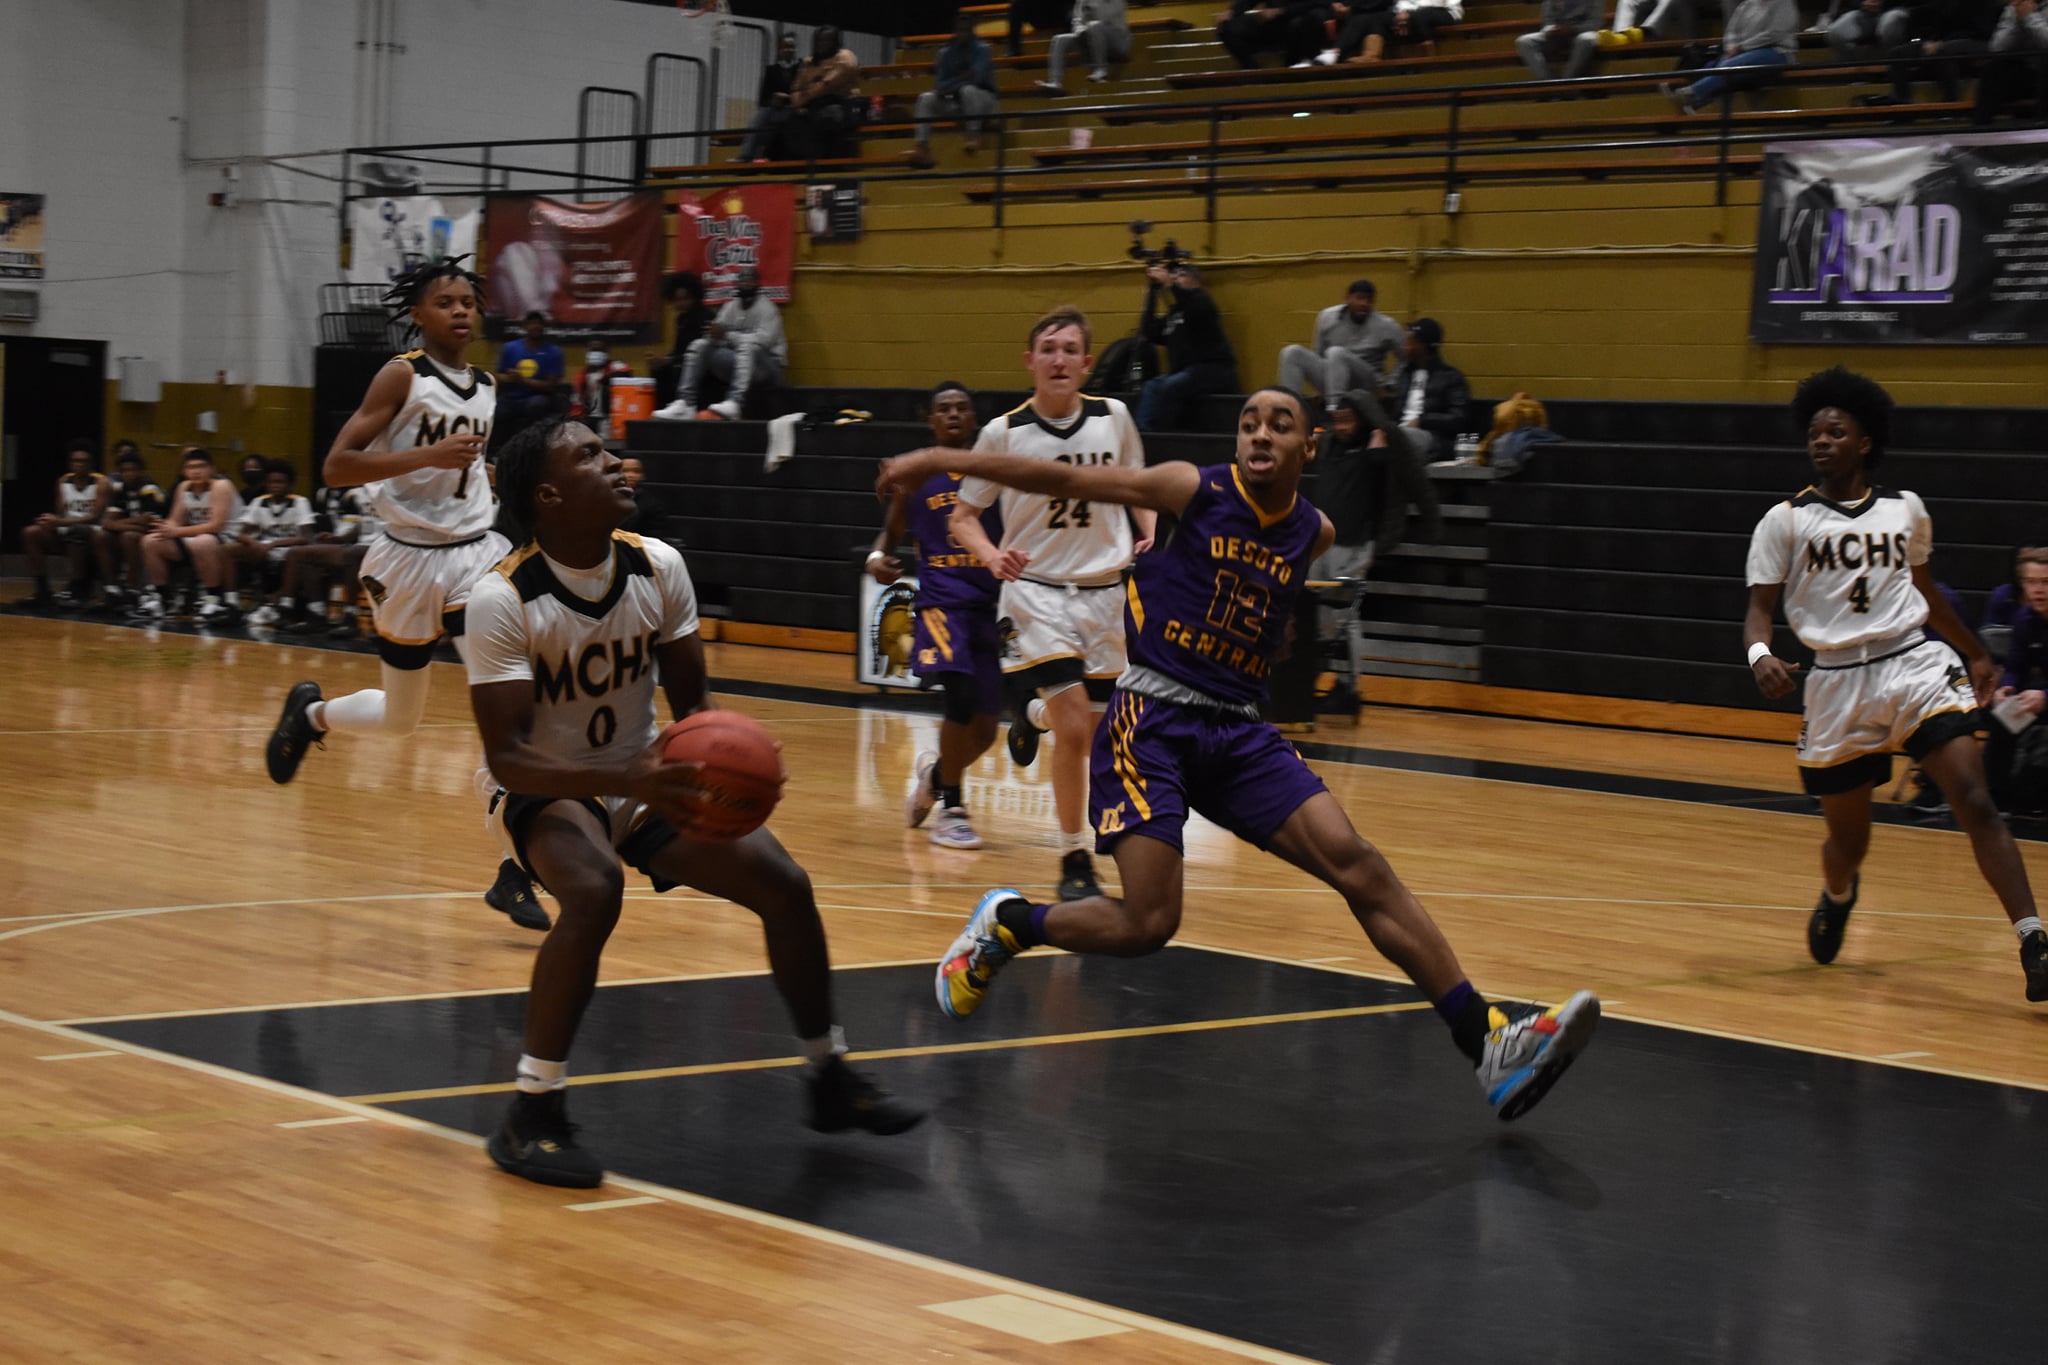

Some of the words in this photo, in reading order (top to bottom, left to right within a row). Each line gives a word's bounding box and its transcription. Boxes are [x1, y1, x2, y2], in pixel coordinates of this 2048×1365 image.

[695, 215, 727, 238] The
[415, 411, 488, 455] MCH
[925, 491, 958, 511] DES
[1047, 497, 1092, 529] 24
[1210, 535, 1293, 586] DESOTO
[1807, 532, 1907, 573] MCHS
[1205, 568, 1271, 643] 12
[1848, 576, 1871, 613] 4
[586, 704, 618, 748] 0
